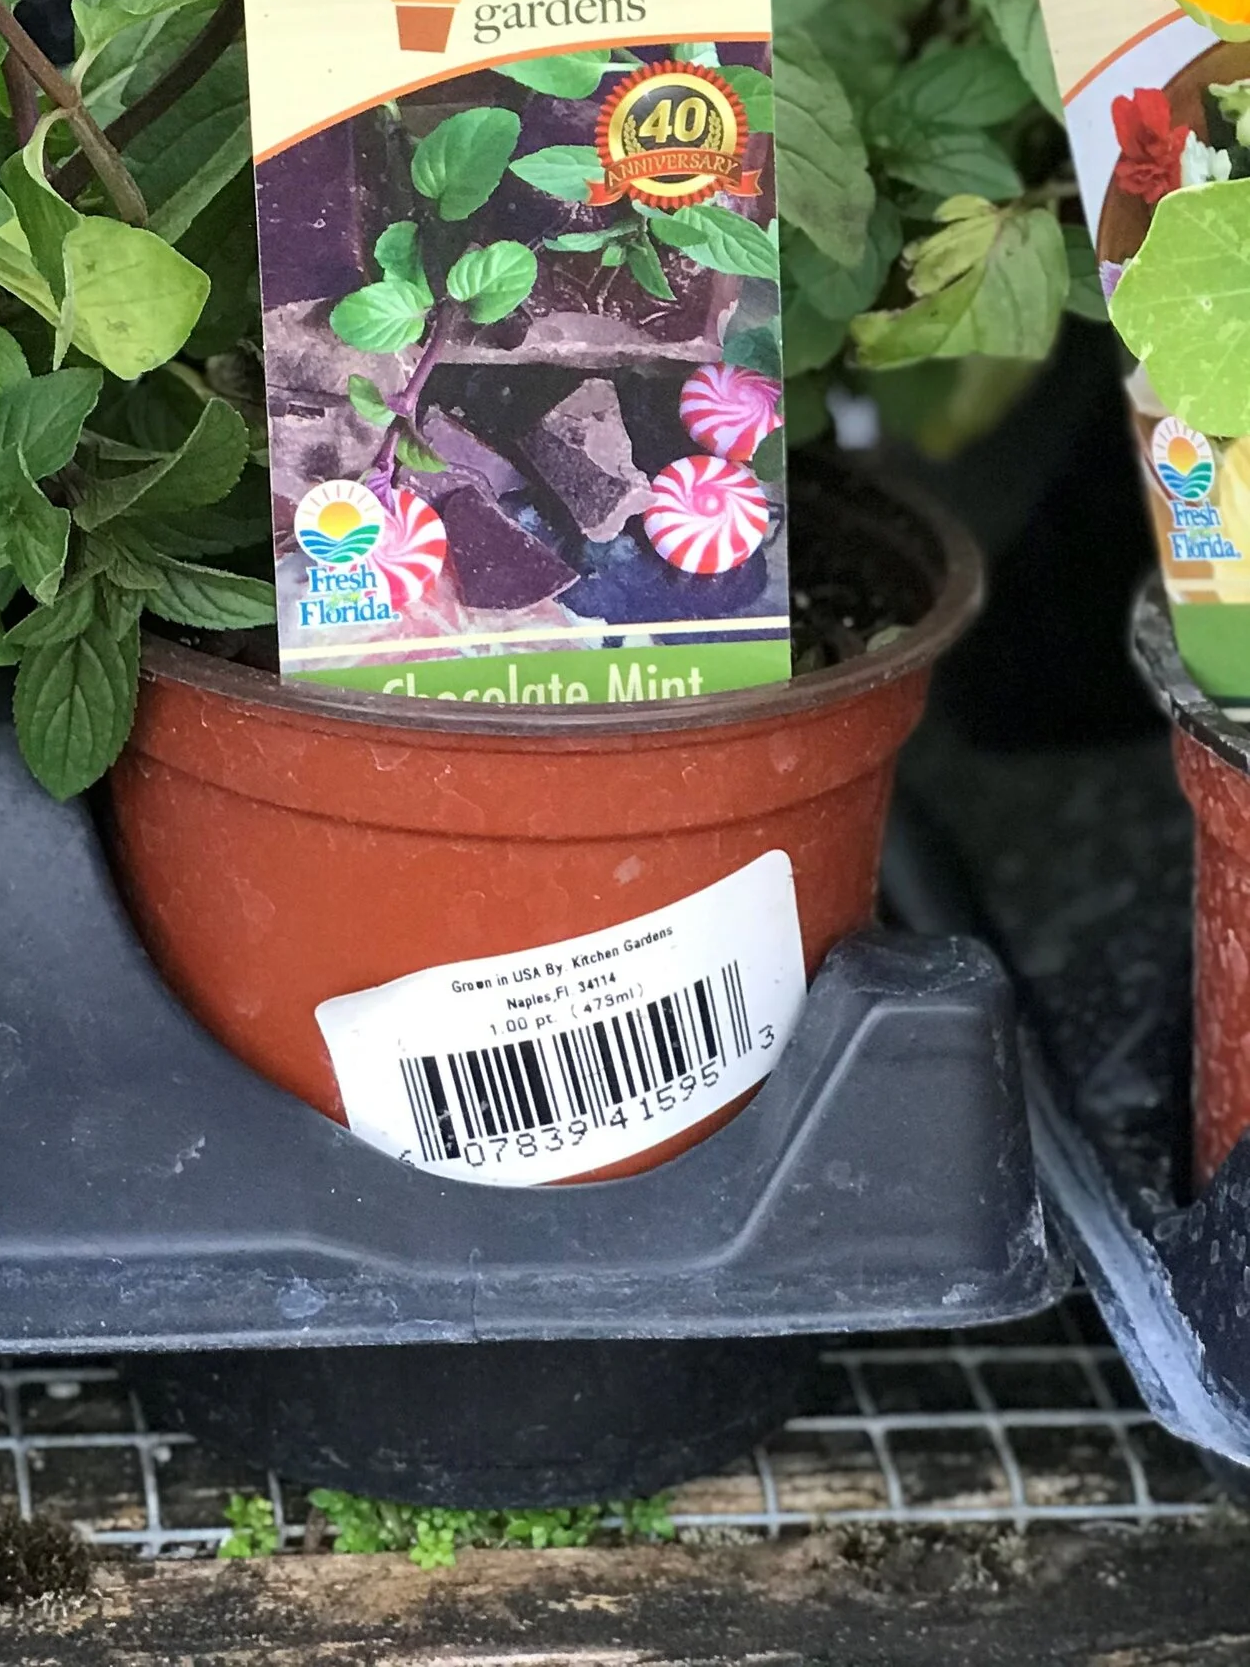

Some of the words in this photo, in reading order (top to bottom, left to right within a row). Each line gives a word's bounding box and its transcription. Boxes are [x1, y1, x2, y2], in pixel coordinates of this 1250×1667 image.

[638, 96, 708, 144] 40
[607, 152, 739, 188] ANNIVERSARY
[1171, 500, 1221, 527] Fresh
[309, 563, 378, 593] Fresh
[496, 973, 509, 987] in
[512, 967, 542, 983] USA
[571, 947, 620, 969] Kitchen
[623, 926, 674, 953] Gardens
[578, 971, 617, 993] 34114
[489, 1016, 529, 1036] 1.00
[758, 1024, 776, 1050] 3
